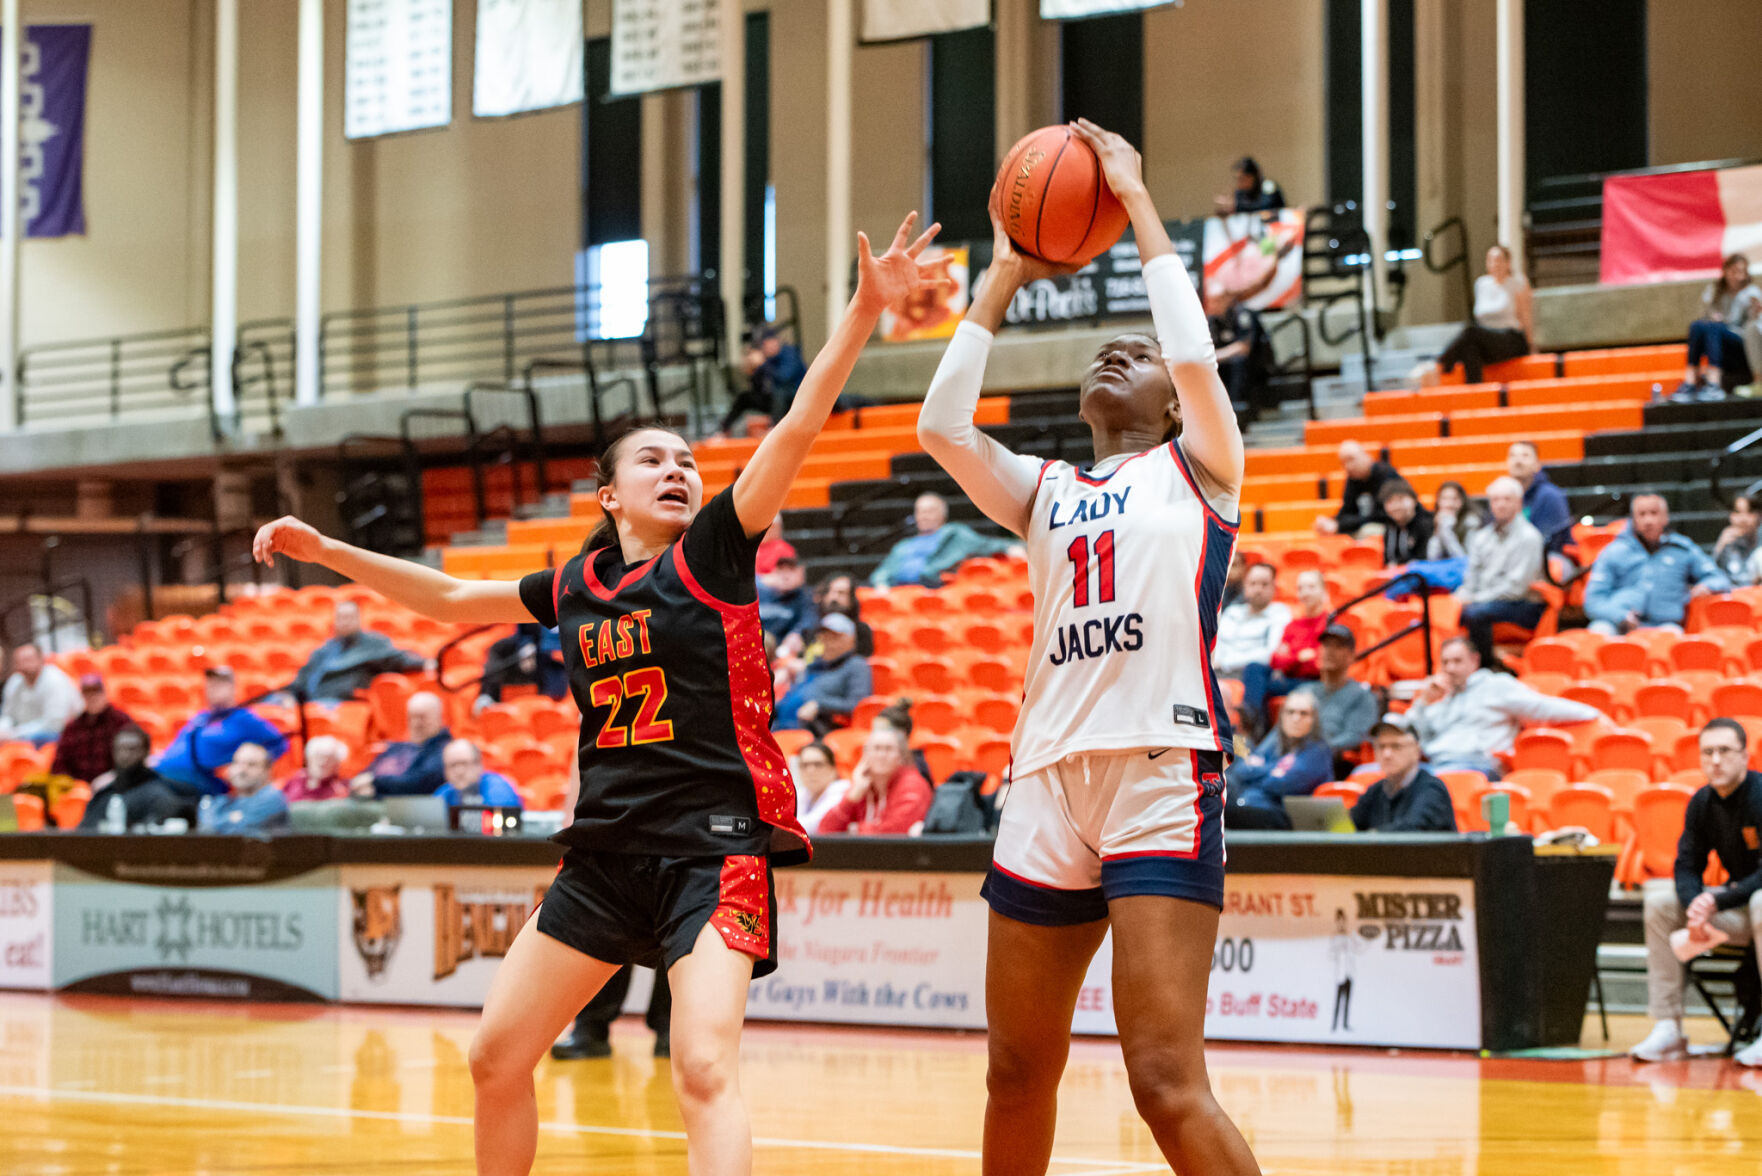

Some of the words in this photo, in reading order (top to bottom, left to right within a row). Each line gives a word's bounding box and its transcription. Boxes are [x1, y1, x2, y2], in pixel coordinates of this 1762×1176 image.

[1049, 485, 1132, 530] LADY
[1067, 529, 1115, 608] 11
[578, 608, 652, 668] EAST
[1049, 612, 1144, 666] JACKS
[589, 665, 675, 749] 22
[803, 879, 849, 926] for
[858, 879, 954, 918] Health
[1354, 891, 1462, 919] MISTER
[82, 909, 148, 946] HART
[197, 910, 304, 950] HOTELS
[1385, 924, 1464, 951] PIZZA
[823, 978, 870, 1006] With
[874, 982, 907, 1008] the
[913, 982, 969, 1011] Cows
[1267, 993, 1319, 1019] State
